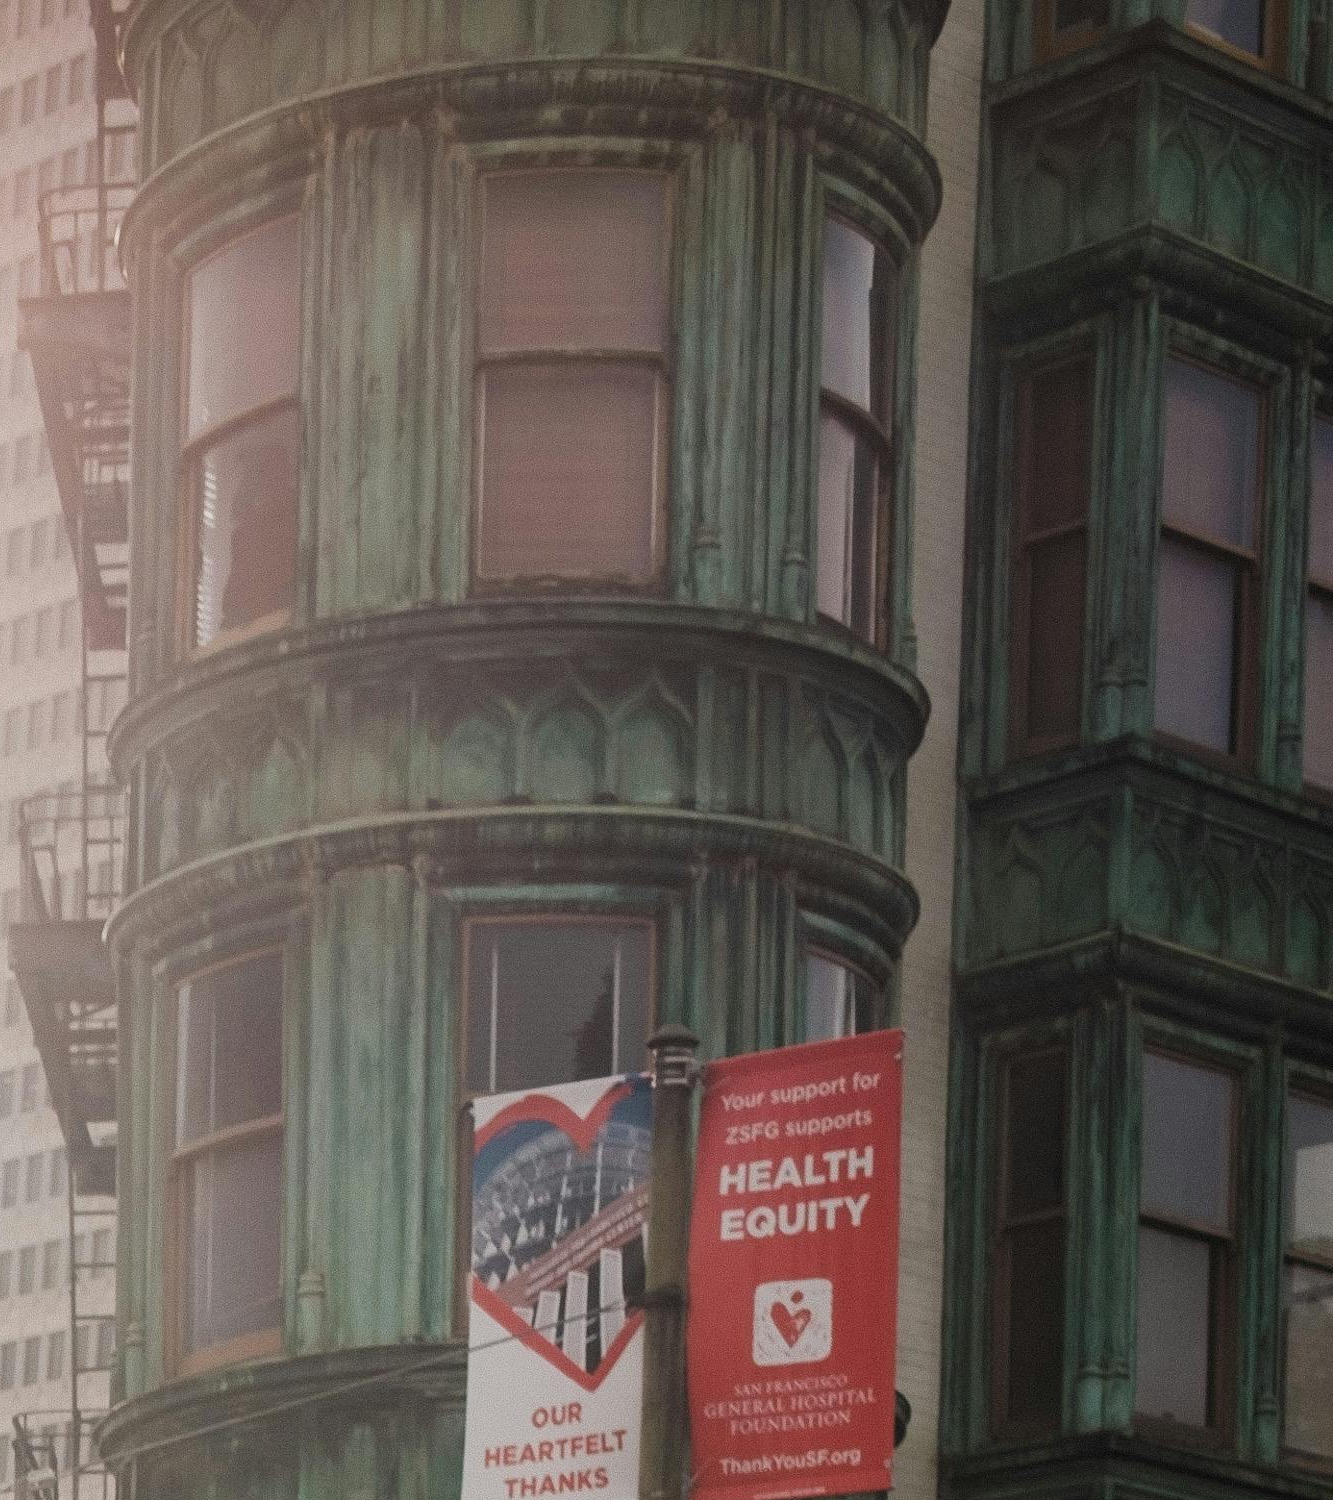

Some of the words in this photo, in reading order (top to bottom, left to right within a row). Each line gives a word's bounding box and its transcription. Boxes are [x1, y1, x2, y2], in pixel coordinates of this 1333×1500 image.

[721, 1088, 766, 1114] Your
[770, 1077, 847, 1109] support
[852, 1070, 881, 1093] for
[725, 1121, 780, 1145] ZSFG
[784, 1109, 874, 1140] supports
[718, 1146, 875, 1196] HEALTH
[720, 1195, 871, 1242] EQUITY
[734, 1380, 764, 1398] SAN
[766, 1373, 849, 1397] FRANCISCO
[530, 1401, 583, 1429] OUR
[704, 1397, 788, 1421] GENERAL
[791, 1387, 877, 1415] HOSPITAL
[730, 1409, 852, 1436] FOUNDATION
[483, 1430, 628, 1468] HEARTFELT
[719, 1447, 862, 1476] ThankYouSF.org
[503, 1467, 609, 1500] THANKS
